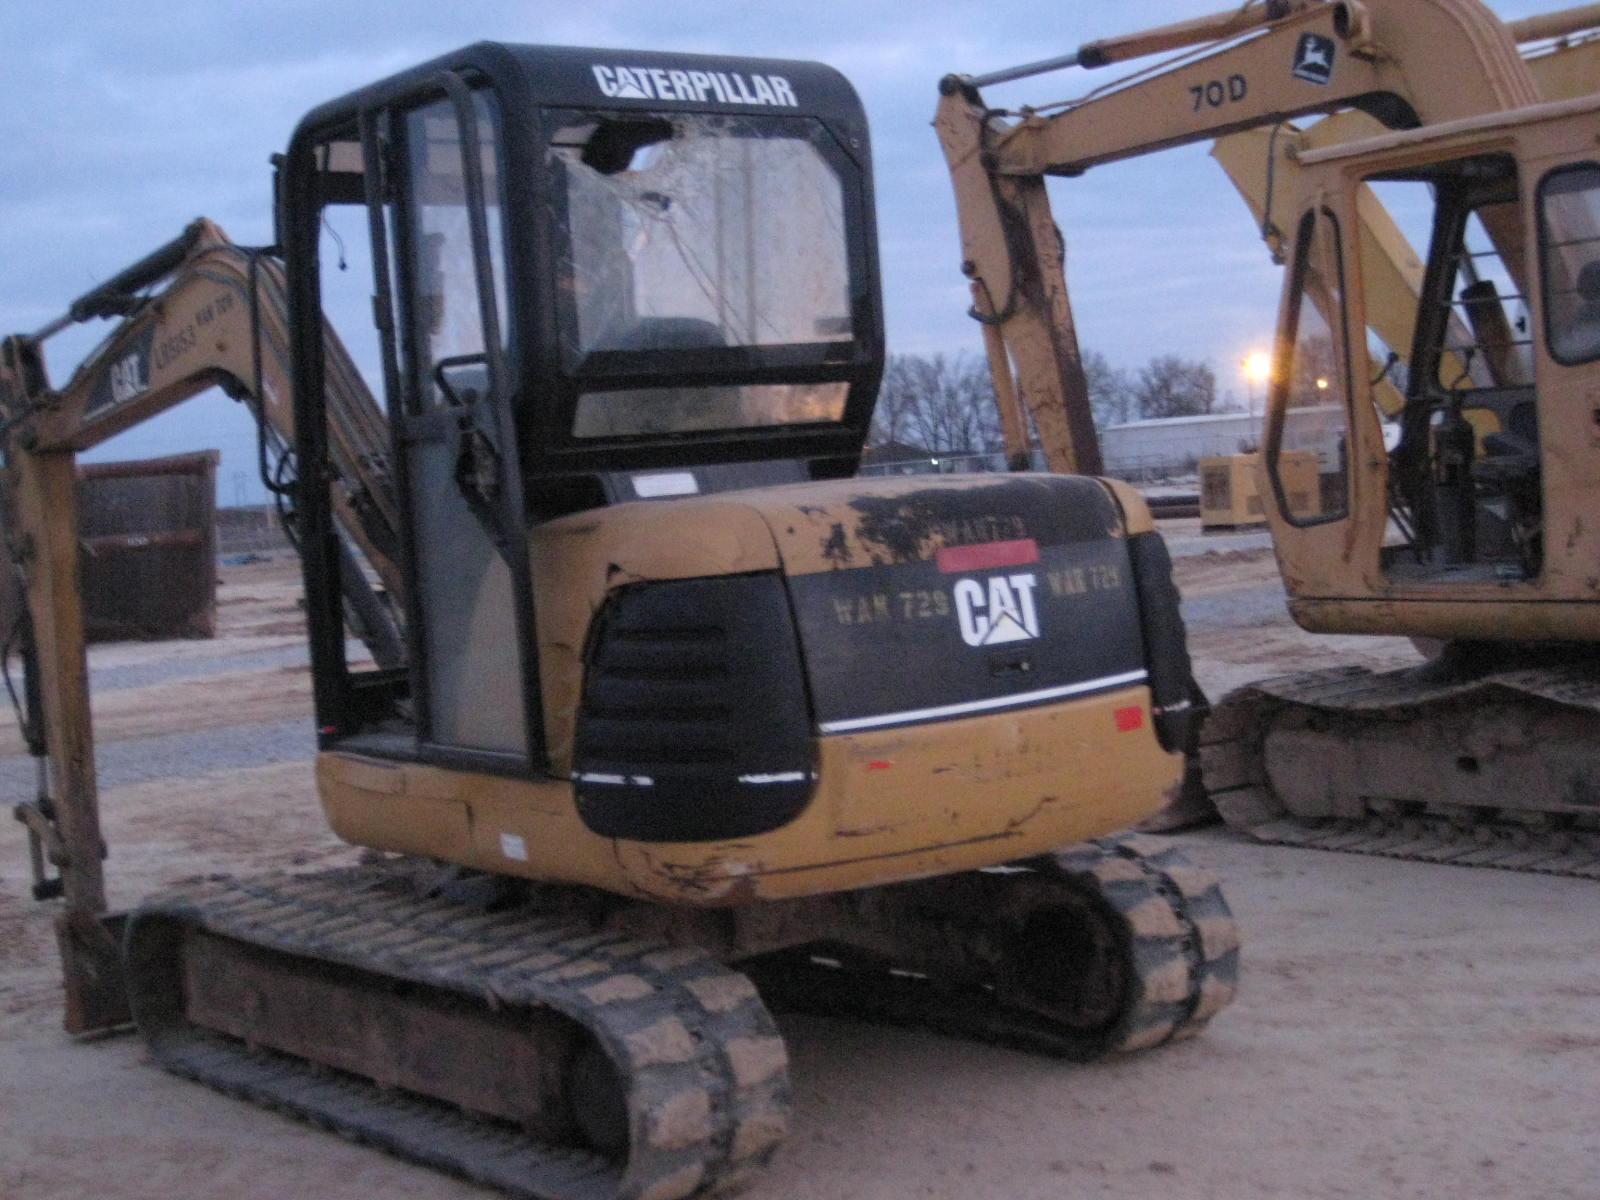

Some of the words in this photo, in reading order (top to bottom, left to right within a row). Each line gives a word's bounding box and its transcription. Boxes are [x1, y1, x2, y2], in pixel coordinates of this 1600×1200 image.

[592, 65, 798, 107] CATERPILLAR
[1189, 74, 1247, 112] 70D
[110, 353, 142, 402] CAT
[954, 574, 1039, 647] CAT
